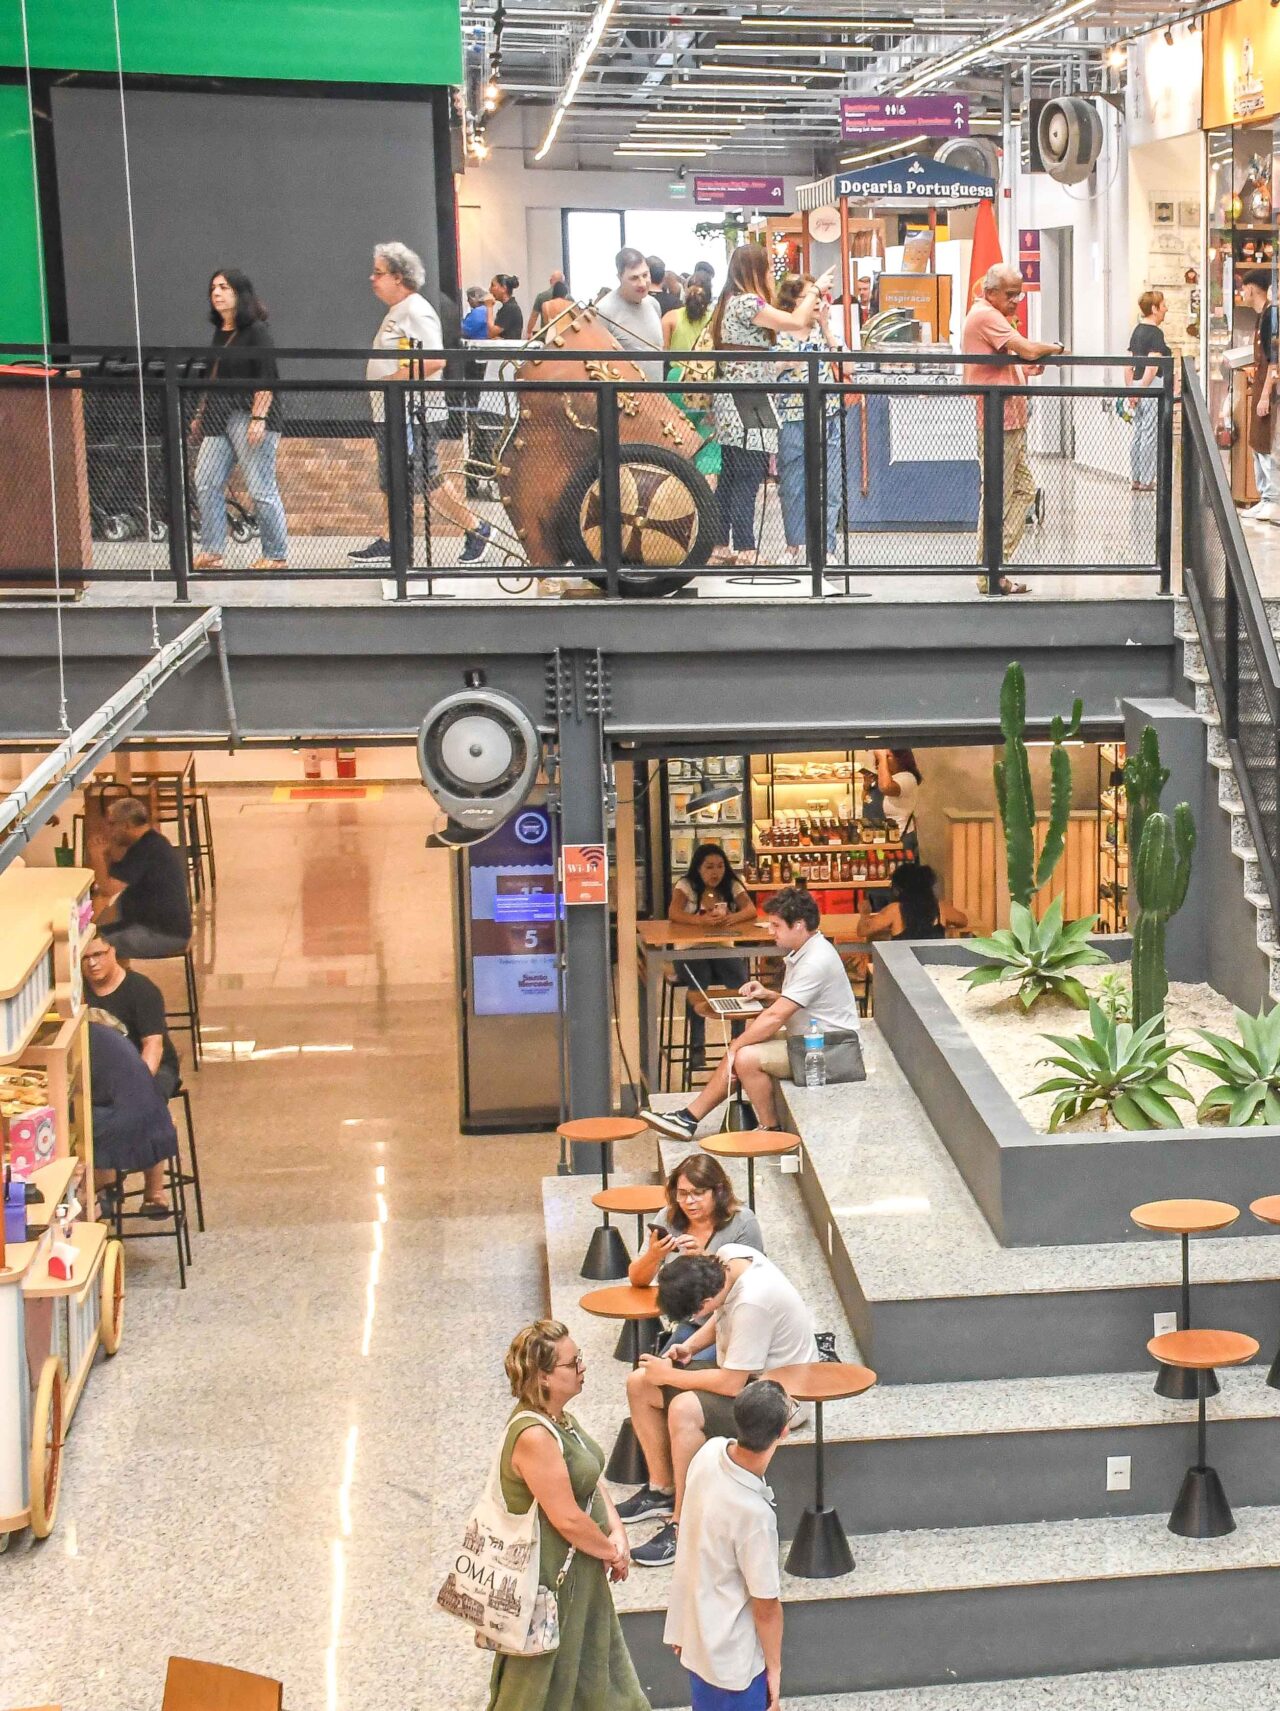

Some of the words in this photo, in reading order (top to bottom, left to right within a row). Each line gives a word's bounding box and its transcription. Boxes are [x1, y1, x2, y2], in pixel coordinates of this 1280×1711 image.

[840, 180, 902, 196] Doçaria
[906, 180, 994, 198] Portuguesa
[524, 929, 538, 948] 5
